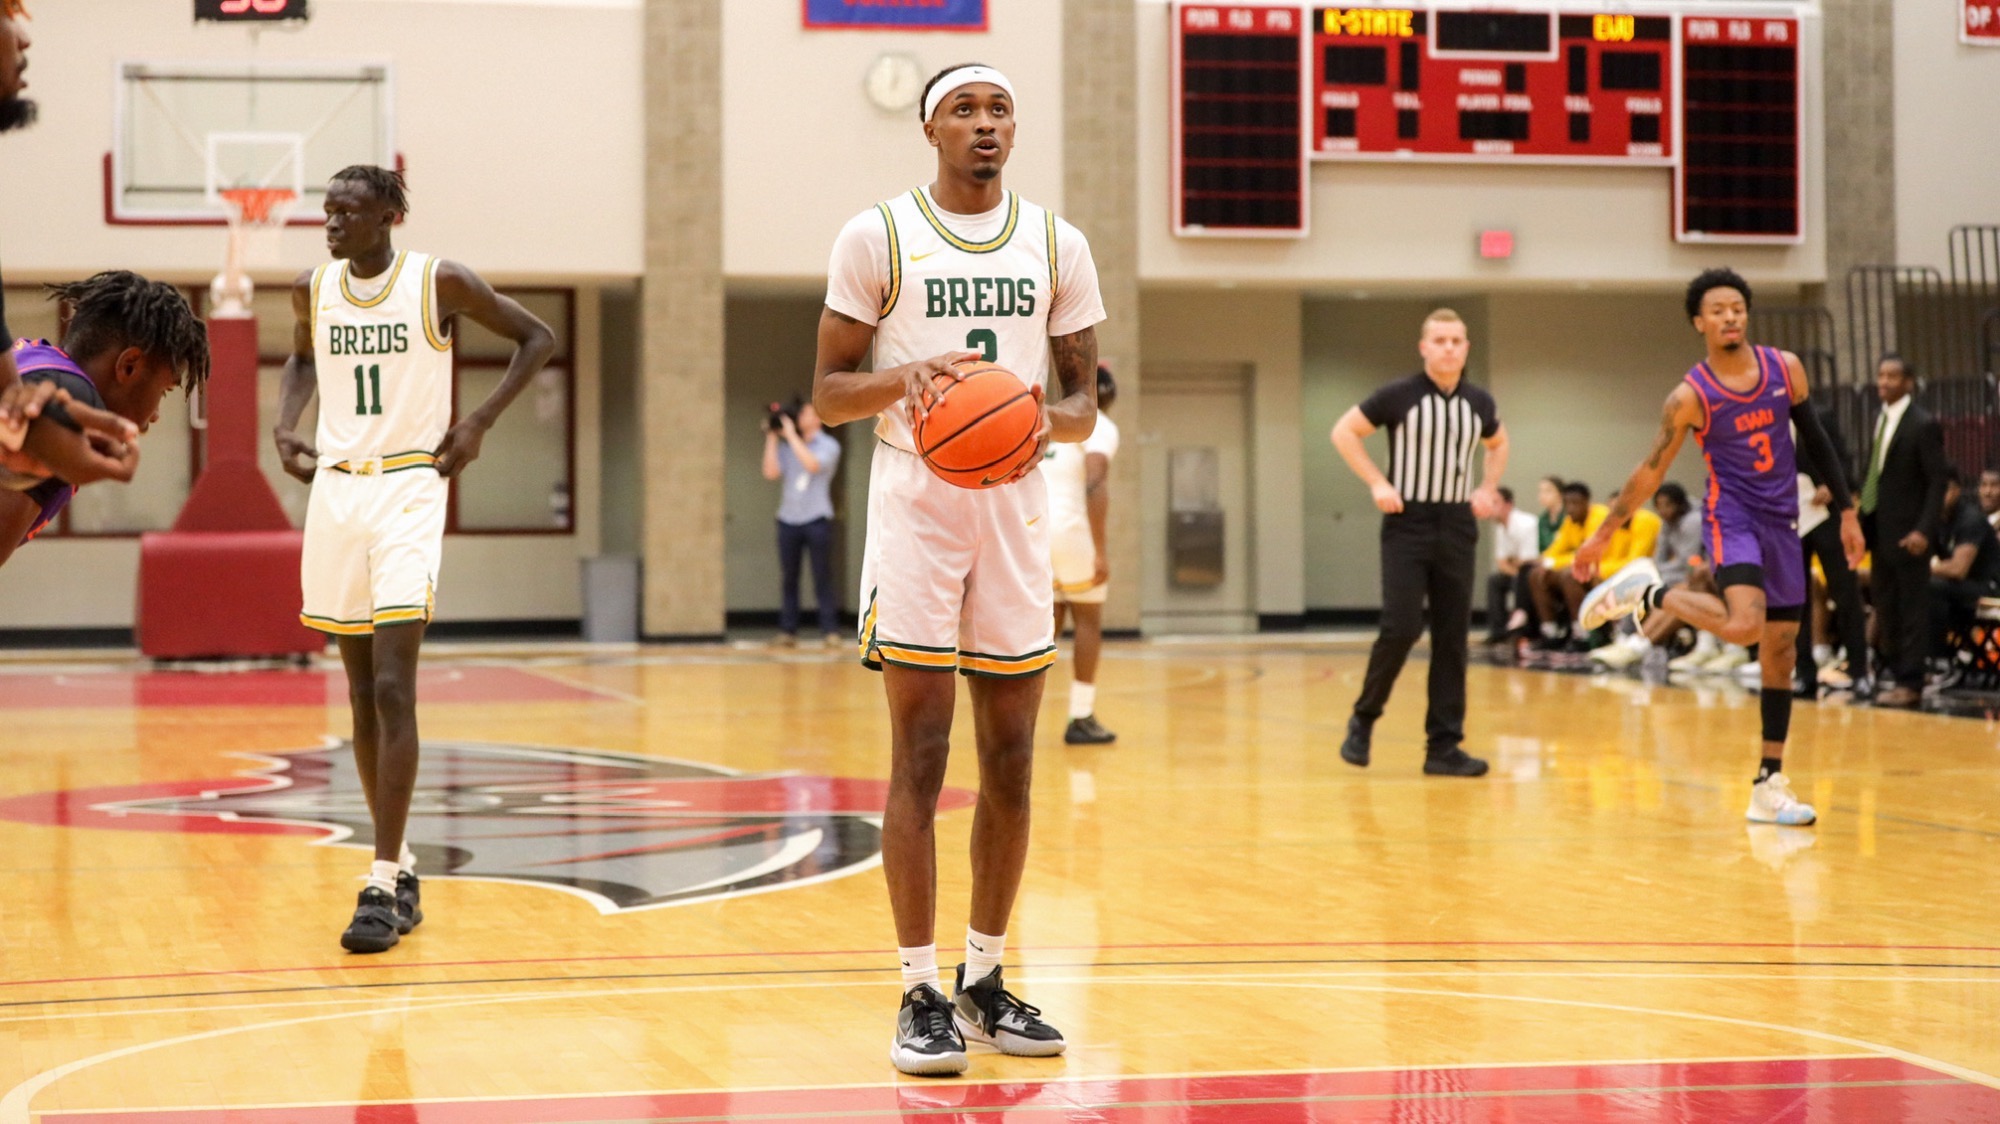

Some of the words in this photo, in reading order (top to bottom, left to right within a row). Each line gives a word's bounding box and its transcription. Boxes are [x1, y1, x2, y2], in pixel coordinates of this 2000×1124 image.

[1324, 8, 1414, 37] K-STATE
[1593, 14, 1634, 42] EWU
[924, 277, 1036, 318] BREDS
[329, 323, 408, 355] BREDS
[354, 364, 382, 415] 11
[1734, 408, 1776, 433] EWU
[1748, 432, 1775, 472] 3
